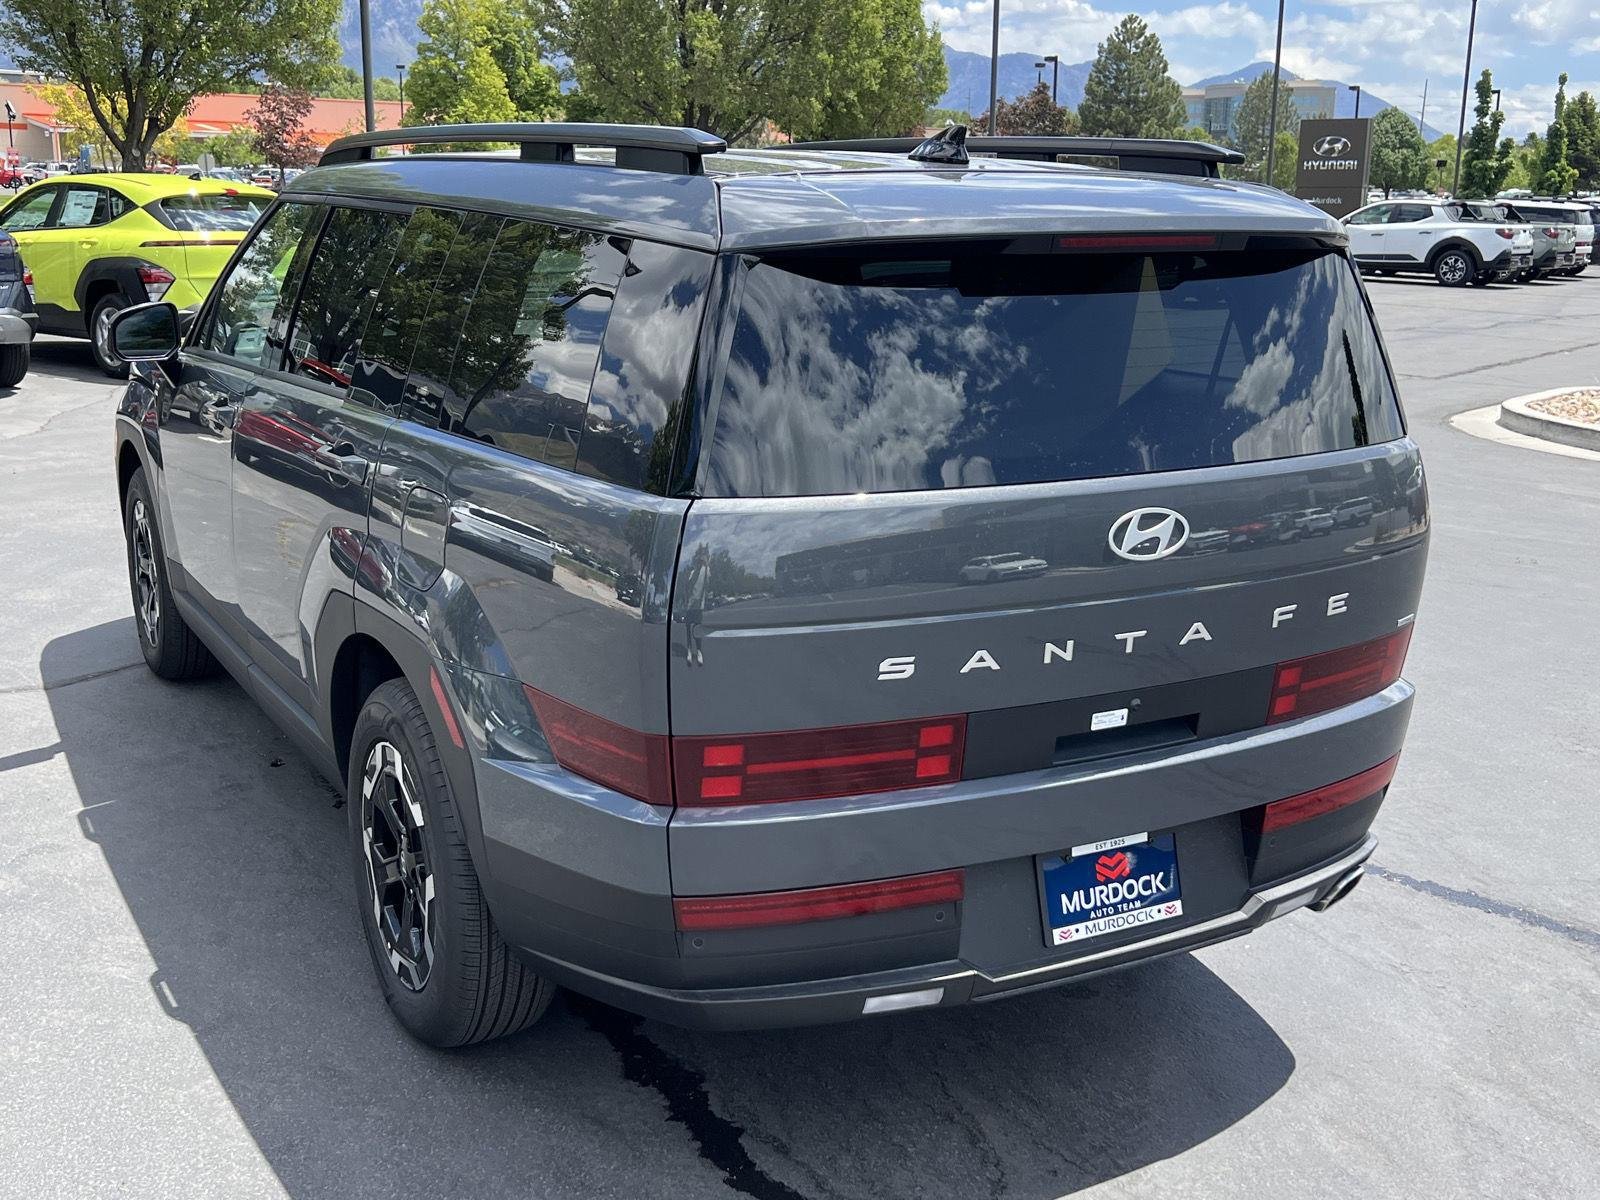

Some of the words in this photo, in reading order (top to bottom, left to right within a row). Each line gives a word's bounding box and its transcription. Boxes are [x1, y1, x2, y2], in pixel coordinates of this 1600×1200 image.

[1303, 160, 1358, 170] HYUNDAI
[877, 621, 1213, 681] SANTA
[1271, 592, 1350, 629] FE
[1095, 842, 1108, 850] EST
[1110, 838, 1126, 847] 1925
[1061, 872, 1167, 914] MURDOCK
[1090, 906, 1115, 919] AUTO
[1117, 900, 1141, 912] TEAM
[1085, 909, 1154, 935] MURDOCK
